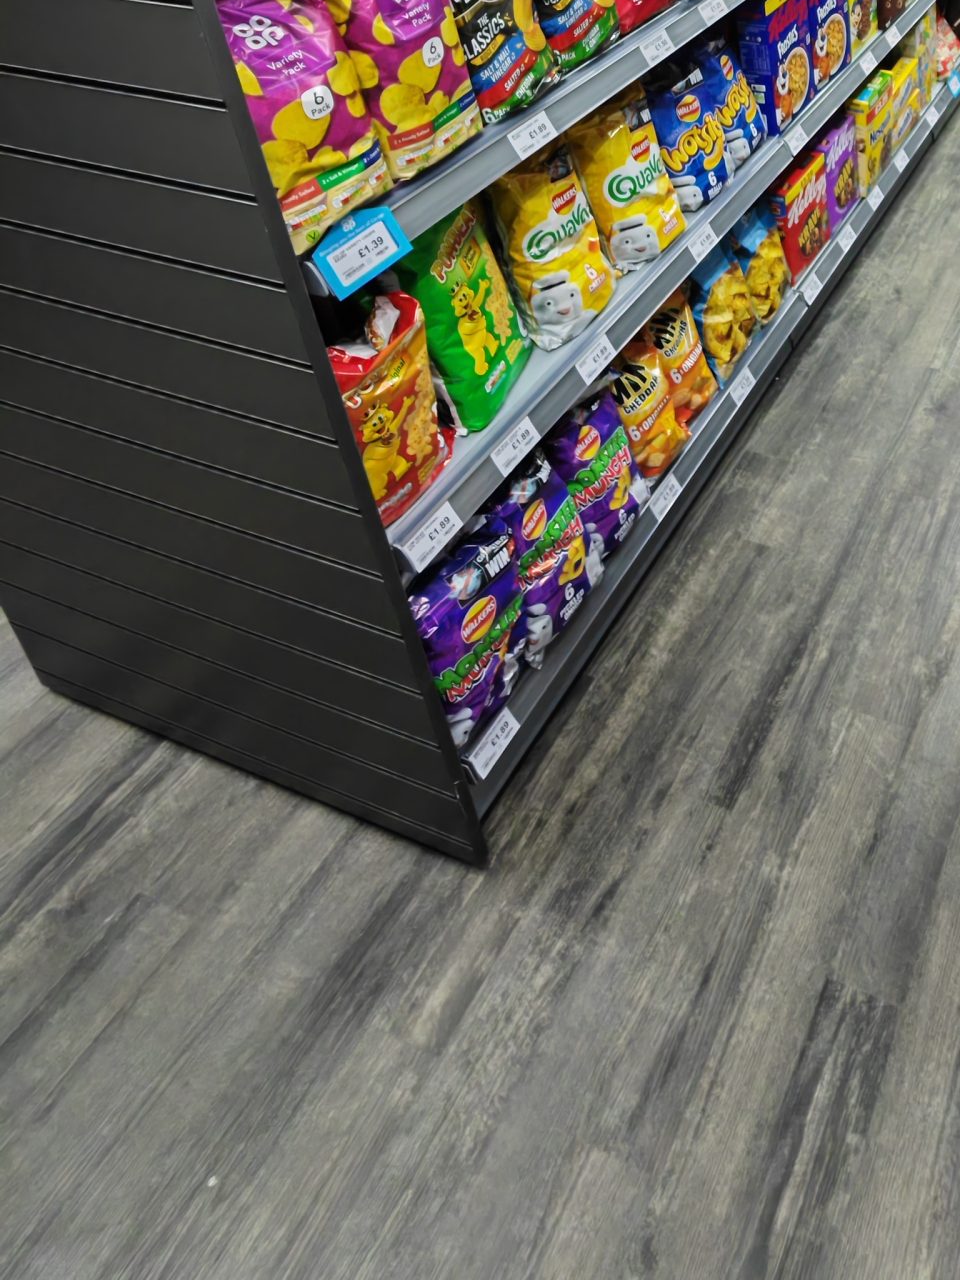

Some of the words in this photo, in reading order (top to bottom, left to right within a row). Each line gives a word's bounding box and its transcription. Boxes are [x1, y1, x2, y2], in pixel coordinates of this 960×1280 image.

[402, 2, 430, 20] Variety
[477, 12, 489, 27] THE
[412, 13, 432, 27] Pack
[430, 41, 436, 55] 6
[266, 50, 303, 71] Variety
[427, 52, 441, 64] Pack
[480, 64, 494, 80] SALT
[491, 59, 512, 83] VINEGAR
[313, 92, 324, 105] 6
[311, 102, 331, 116] Pack
[482, 107, 494, 123] 6
[677, 99, 699, 116] WALKERS
[529, 124, 547, 140] £1.89
[750, 124, 758, 136] 6
[631, 136, 650, 160] WALKERS
[708, 172, 716, 185] 6
[552, 184, 577, 208] WALKERS
[358, 236, 384, 258] £1.39
[585, 264, 597, 280] 6
[670, 368, 681, 384] 6
[511, 429, 530, 450] £1.89
[628, 425, 641, 441] 6
[576, 430, 598, 456] WALKERS
[574, 445, 631, 509] MUNCH
[428, 516, 450, 541] £1.89
[523, 504, 546, 538] WALKERS
[485, 547, 510, 578] WIN
[564, 584, 575, 601] 6
[463, 600, 496, 639] WALKERS
[491, 721, 509, 746] £1.89
